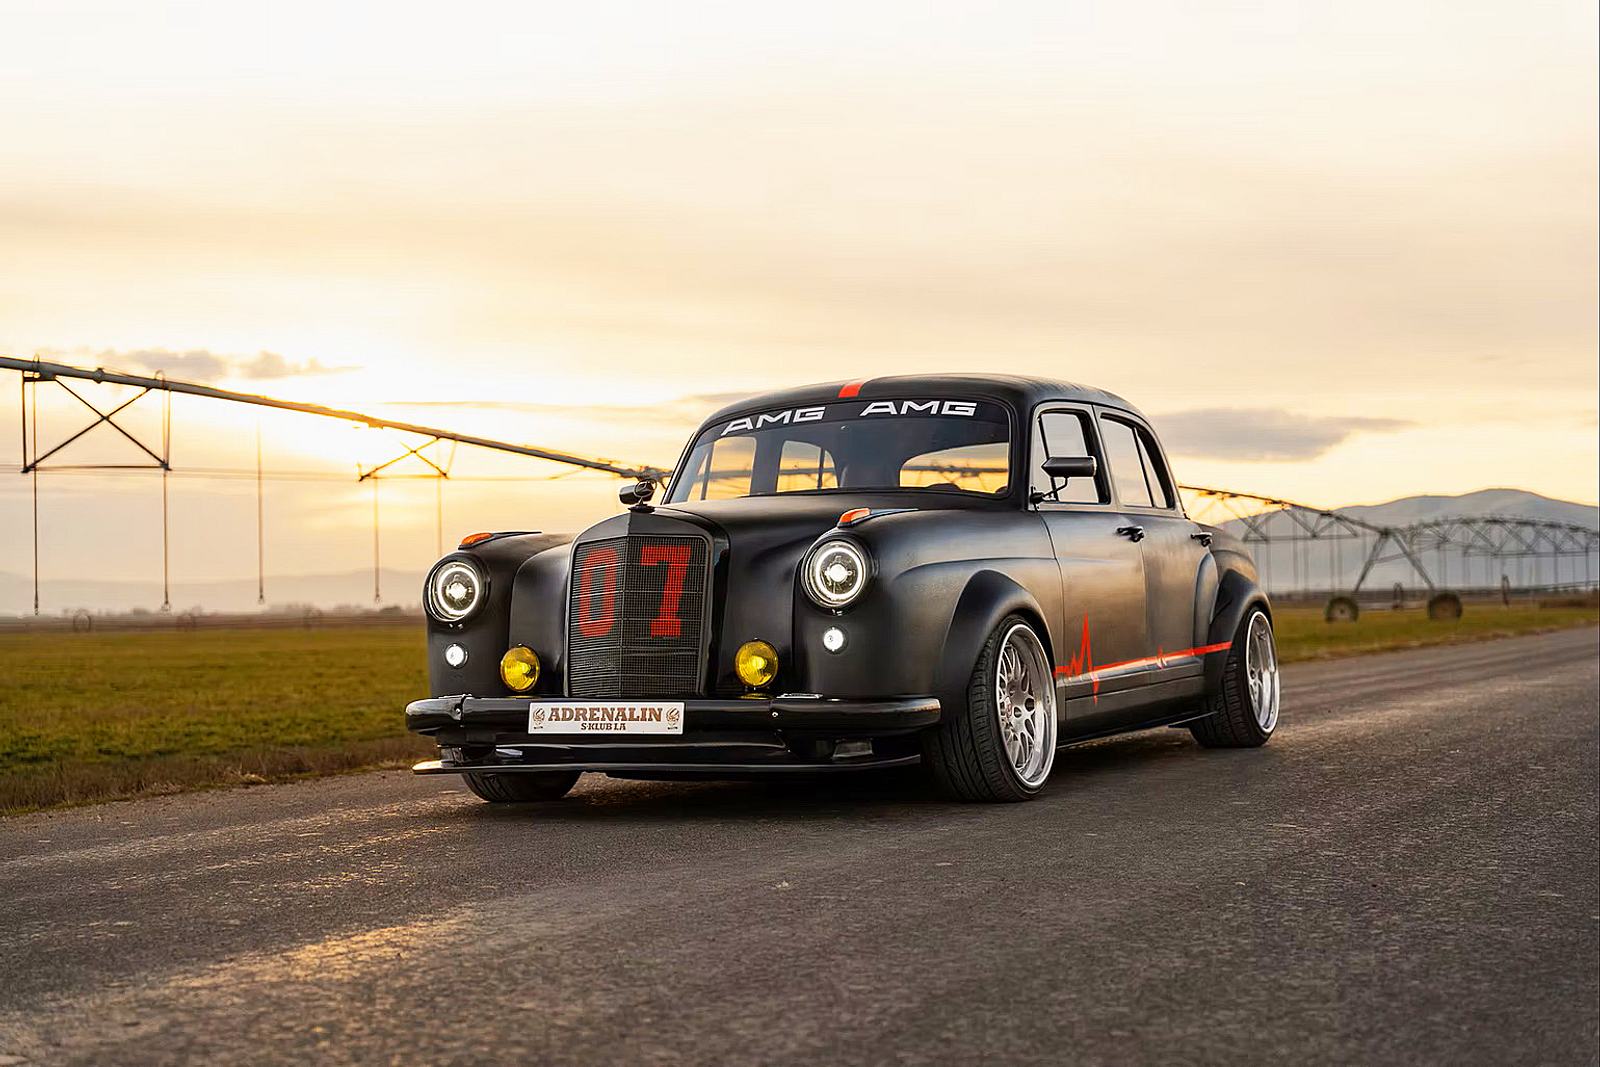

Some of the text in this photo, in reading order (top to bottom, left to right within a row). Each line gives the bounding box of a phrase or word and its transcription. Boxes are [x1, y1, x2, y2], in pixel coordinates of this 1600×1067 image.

[721, 400, 977, 436] AMG AMG
[579, 545, 691, 639] 07
[548, 707, 663, 722] ADRENALIN
